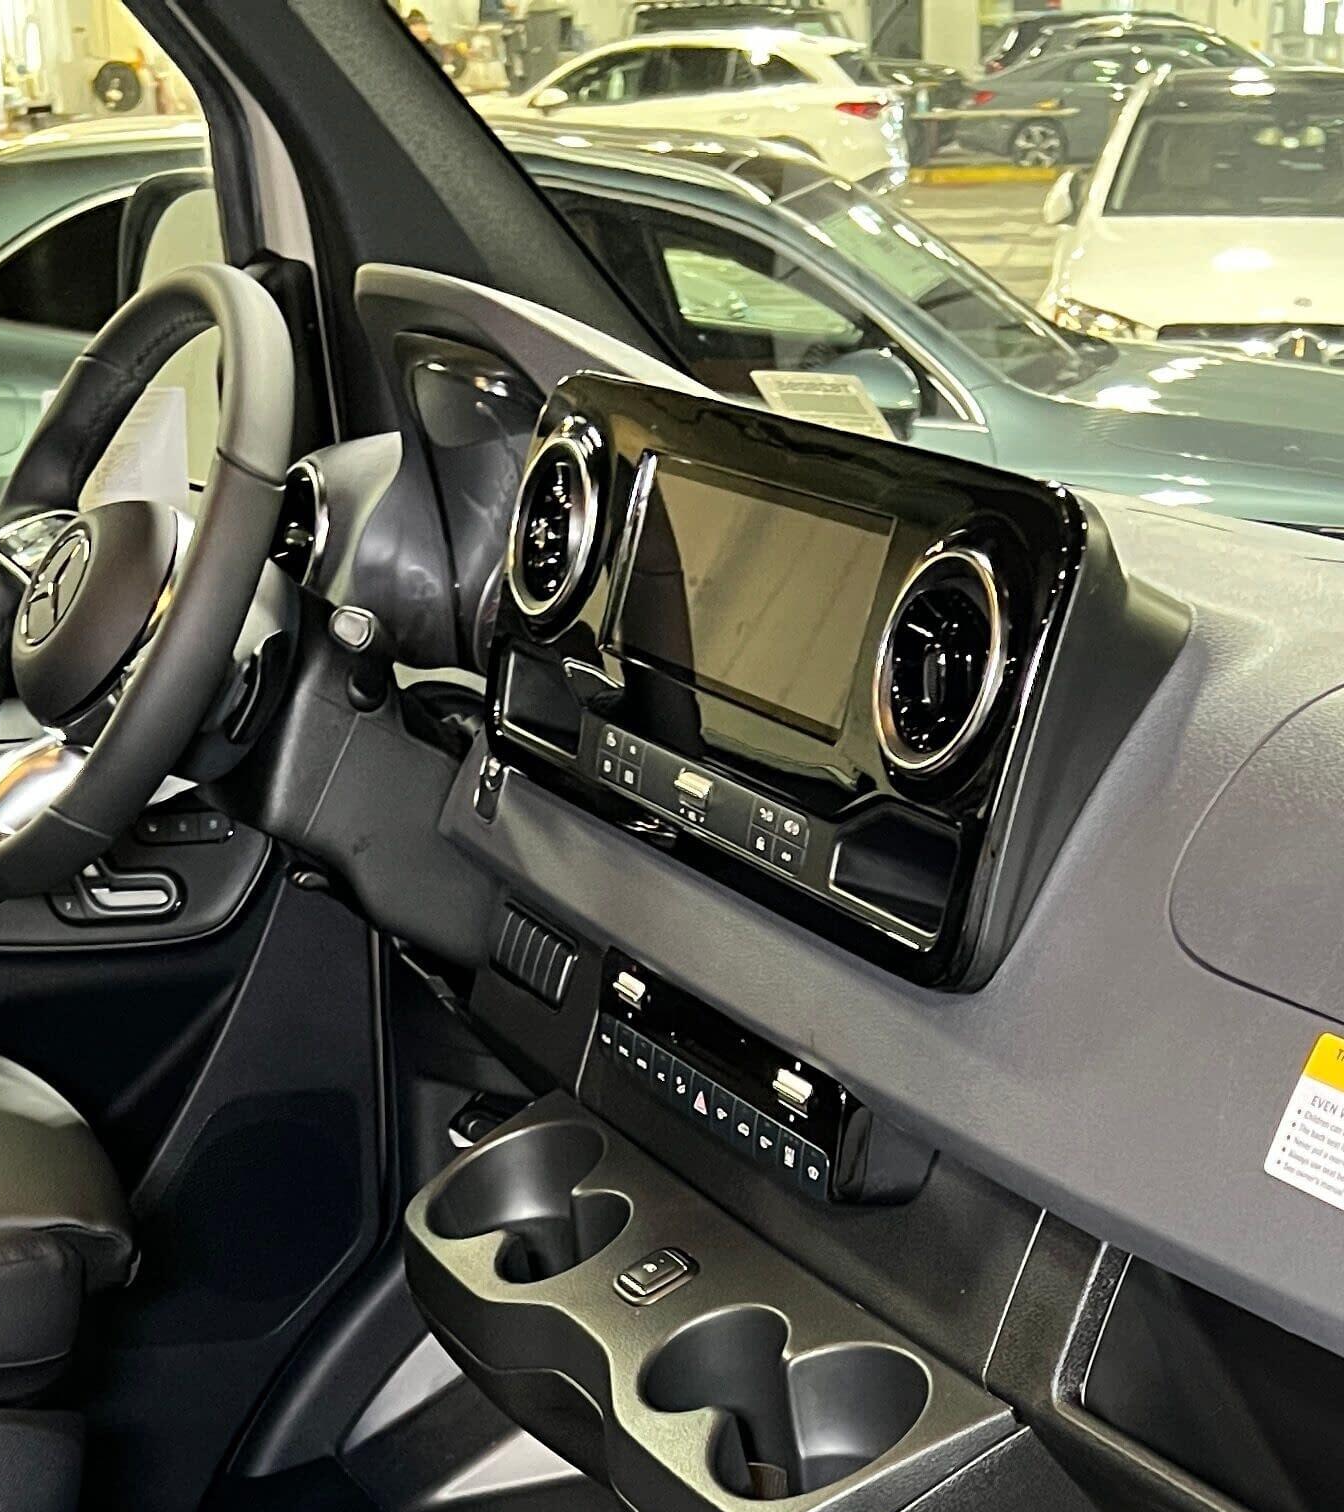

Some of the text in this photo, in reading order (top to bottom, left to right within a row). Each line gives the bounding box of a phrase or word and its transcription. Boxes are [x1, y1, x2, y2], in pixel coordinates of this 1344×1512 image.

[1311, 1096, 1337, 1114] EVEN
[1299, 1124, 1311, 1134] The
[1304, 1111, 1329, 1127] Children
[1331, 1125, 1343, 1134] can
